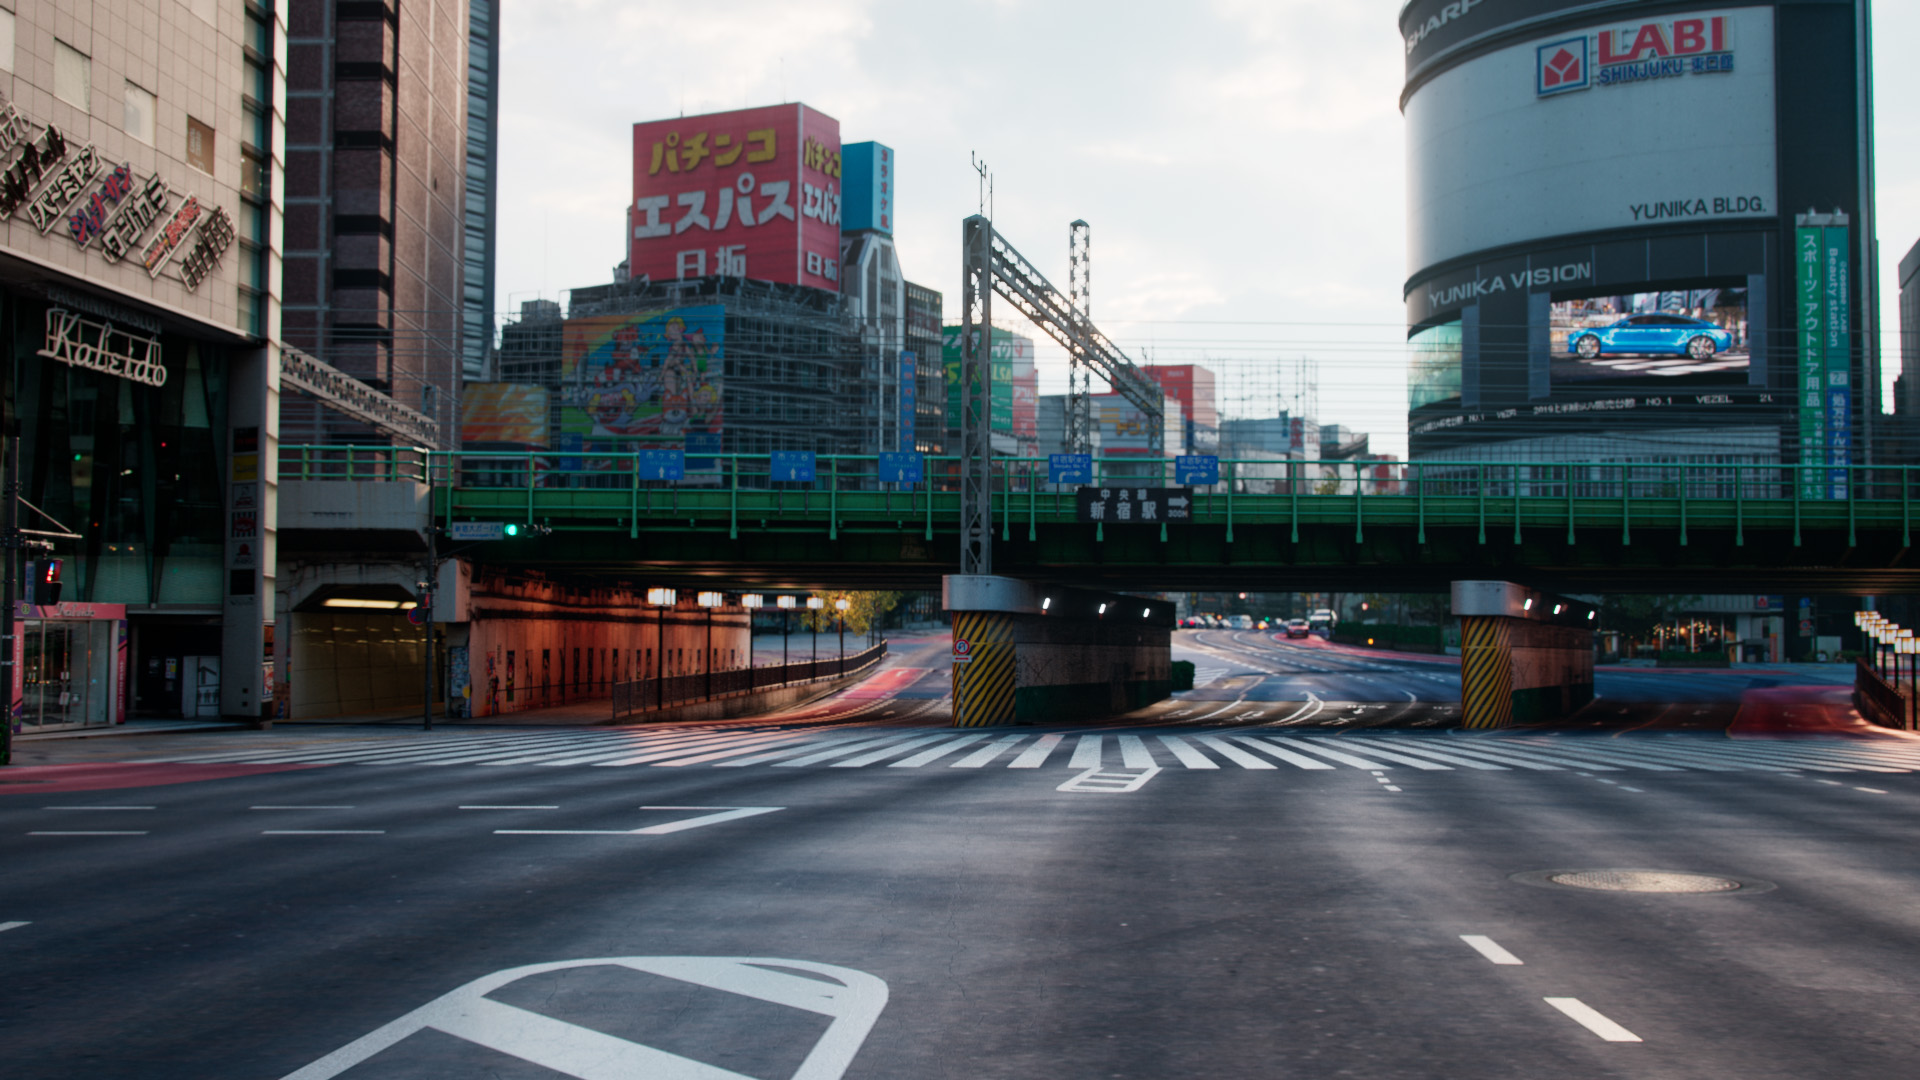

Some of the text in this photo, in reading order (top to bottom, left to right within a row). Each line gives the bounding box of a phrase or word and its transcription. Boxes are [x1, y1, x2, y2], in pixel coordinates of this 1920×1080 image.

[1598, 16, 1725, 66] LABI
[1599, 58, 1682, 84] SHINJUKU
[649, 128, 776, 175] パチンコ
[804, 135, 840, 179] パチンコ
[31, 144, 100, 231] バーミヤン
[69, 160, 132, 246] ジョナサン
[634, 171, 796, 240] エスパス
[803, 181, 840, 226] エスパス
[1629, 196, 1767, 221] YUNIKA BLDG.
[1429, 262, 1591, 309] YUNIKA VISION
[1827, 247, 1840, 347] Beauty station
[1803, 234, 1821, 408] スポーツ・アウトドア用品
[36, 307, 168, 388] Kaleido
[1694, 394, 1732, 405] VEZEL
[1090, 500, 1157, 520] 新宿駅
